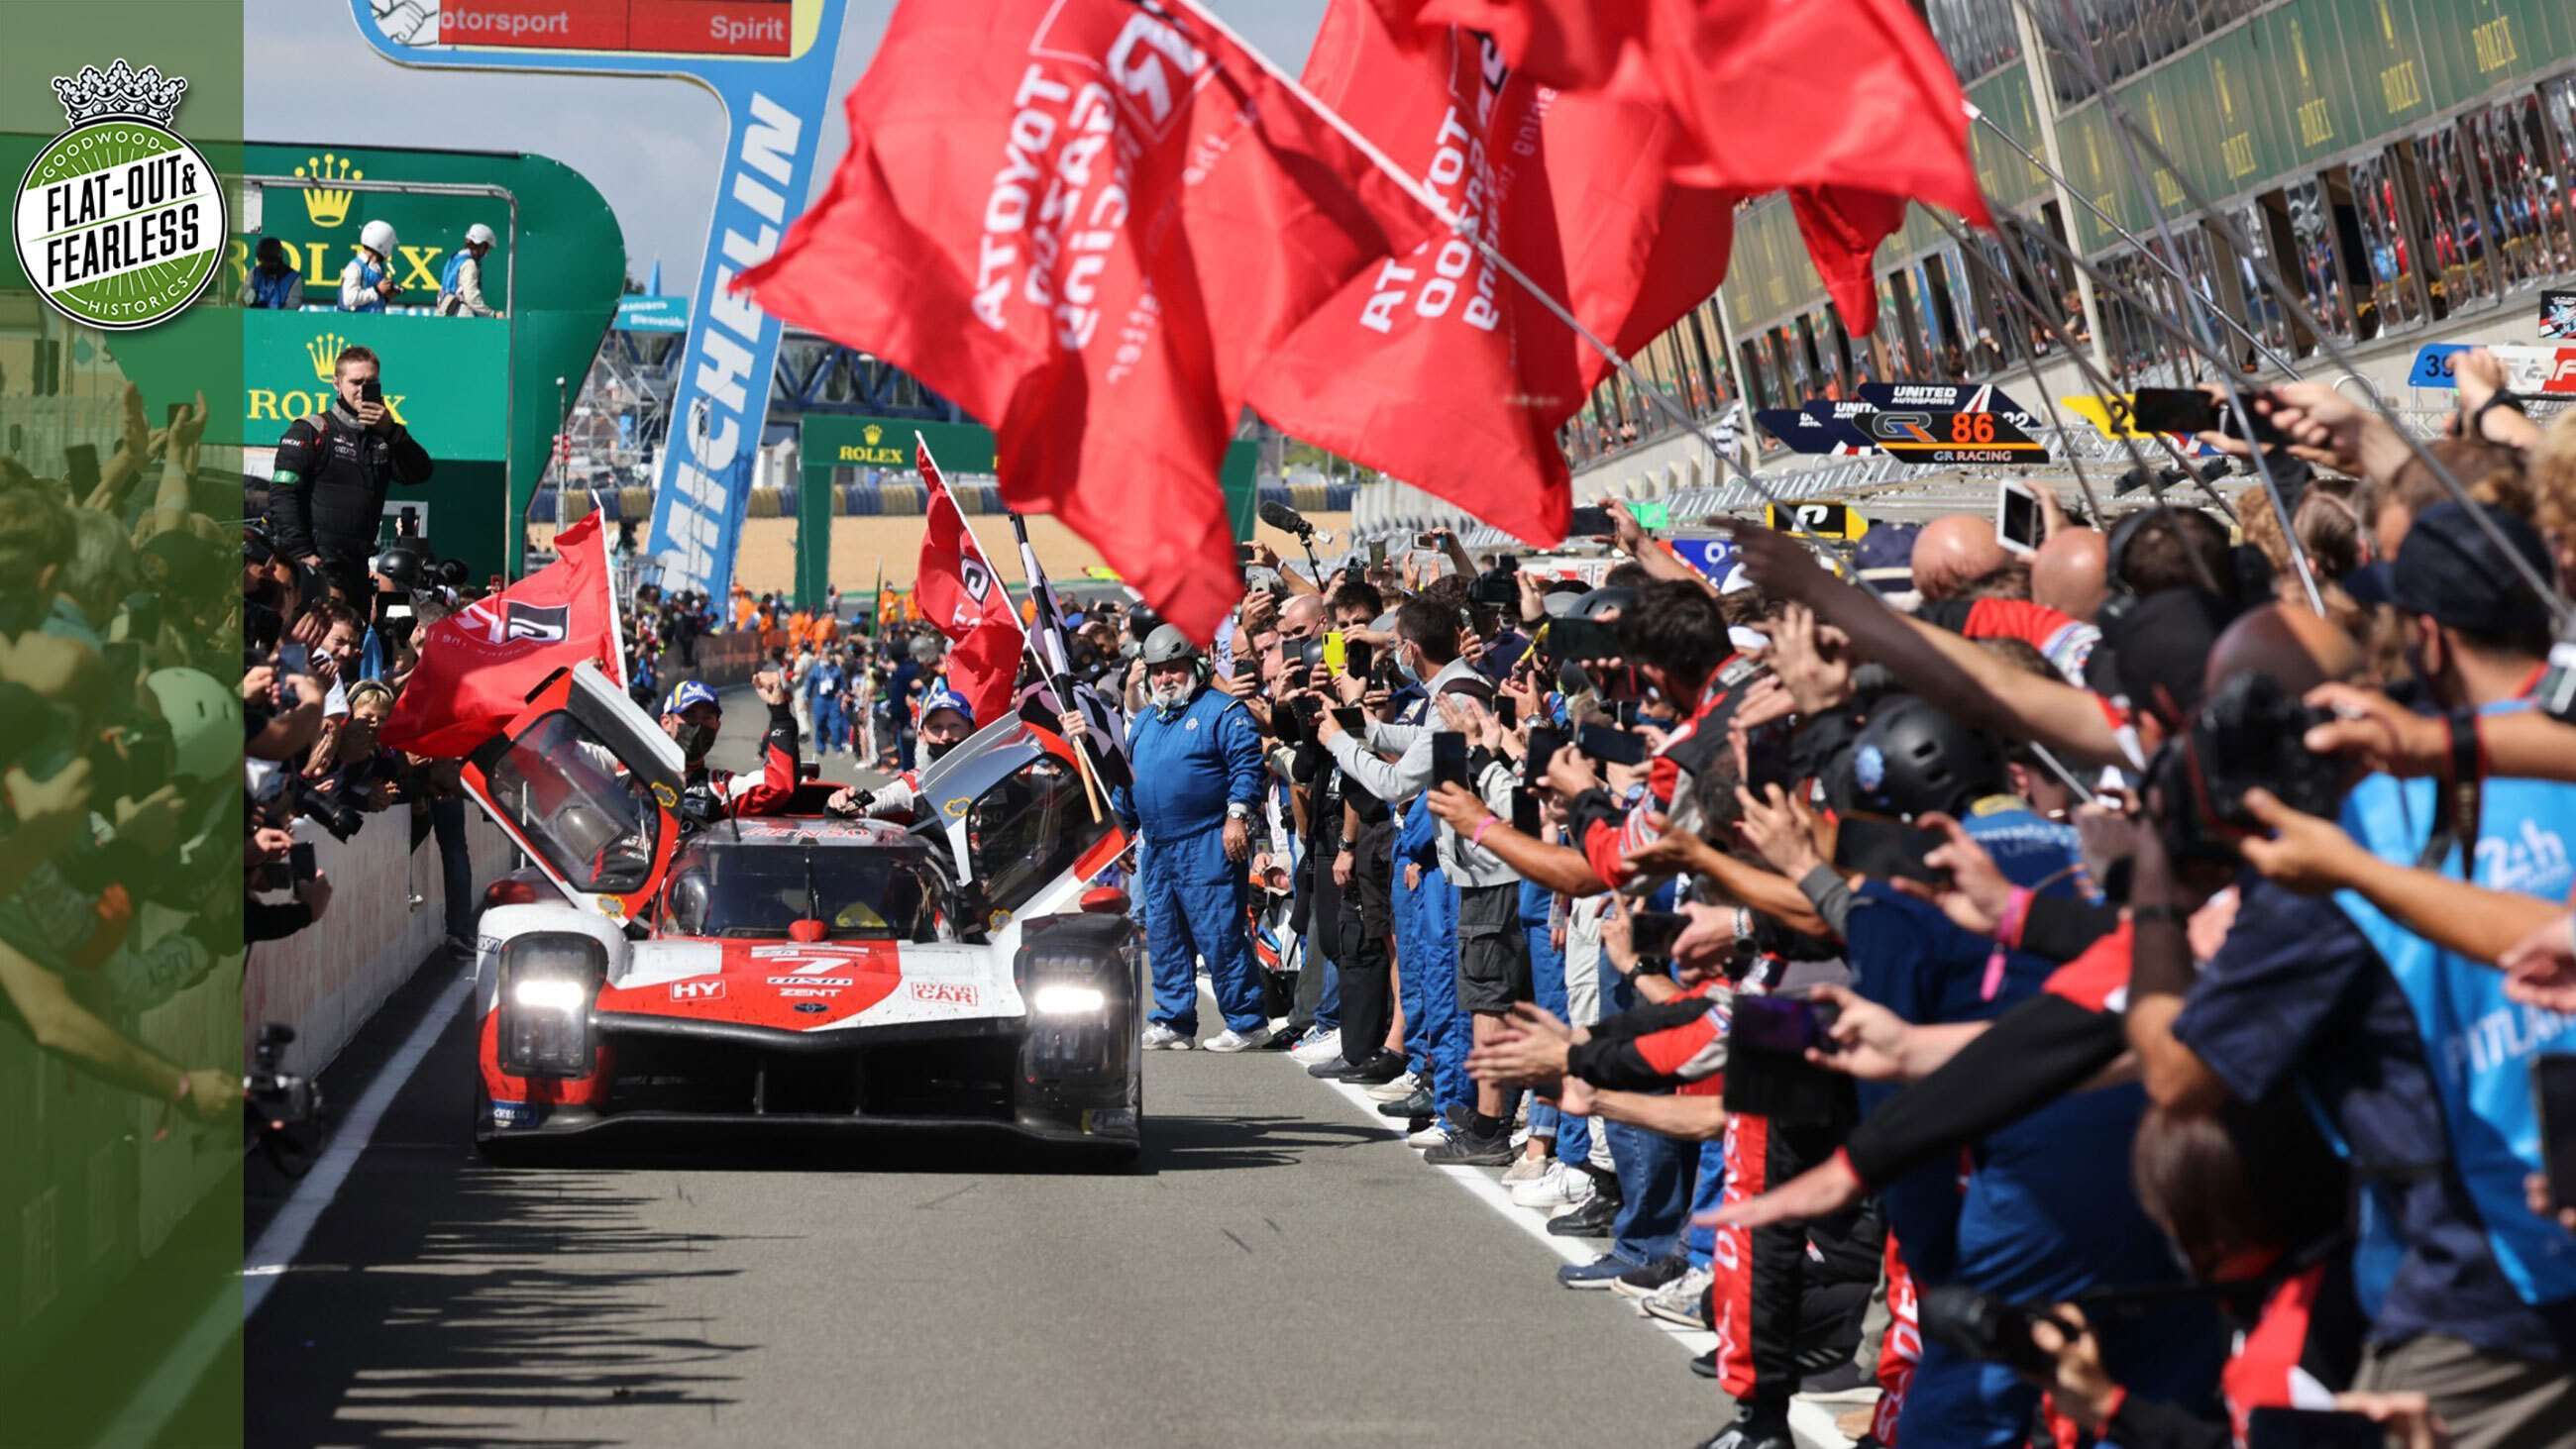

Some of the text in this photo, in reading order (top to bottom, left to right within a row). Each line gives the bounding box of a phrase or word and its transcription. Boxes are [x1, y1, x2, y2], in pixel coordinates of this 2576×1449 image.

[708, 15, 785, 45] Spirit
[657, 91, 803, 595] MICHELIN
[1893, 385, 1958, 397] UNITED
[1891, 397, 1956, 406] AUTOSPORTS
[1952, 412, 1994, 444] 86
[839, 446, 903, 464] ROLEX
[1934, 451, 2012, 463] GR RACING
[770, 957, 851, 975] 7
[673, 982, 721, 999] HY
[916, 989, 972, 1003] CAR
